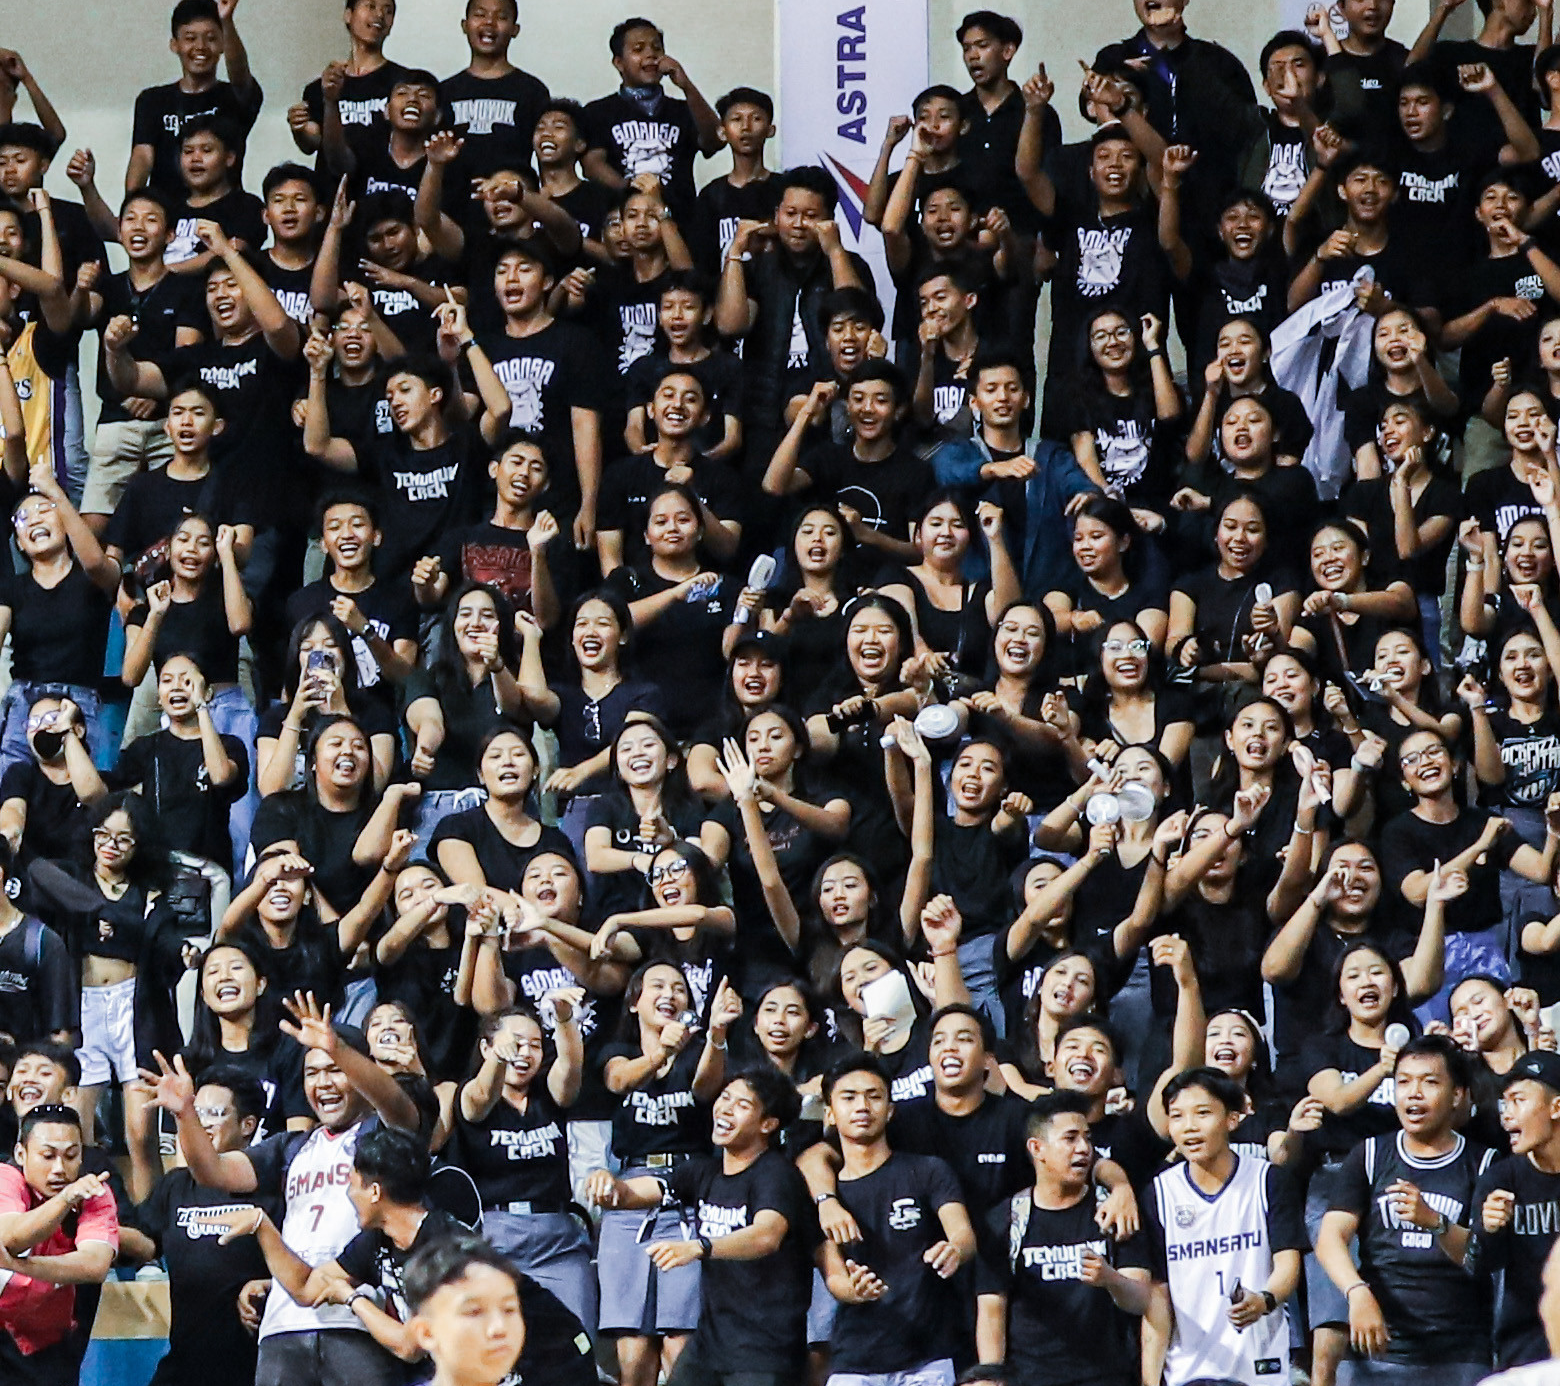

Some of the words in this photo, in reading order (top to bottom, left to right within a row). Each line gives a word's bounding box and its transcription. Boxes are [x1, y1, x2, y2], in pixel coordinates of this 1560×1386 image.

[837, 6, 867, 144] ASTRA
[408, 480, 448, 502] CREW
[508, 1139, 556, 1160] CREW
[310, 1205, 324, 1233] 7
[1168, 1229, 1262, 1261] SMANSATU
